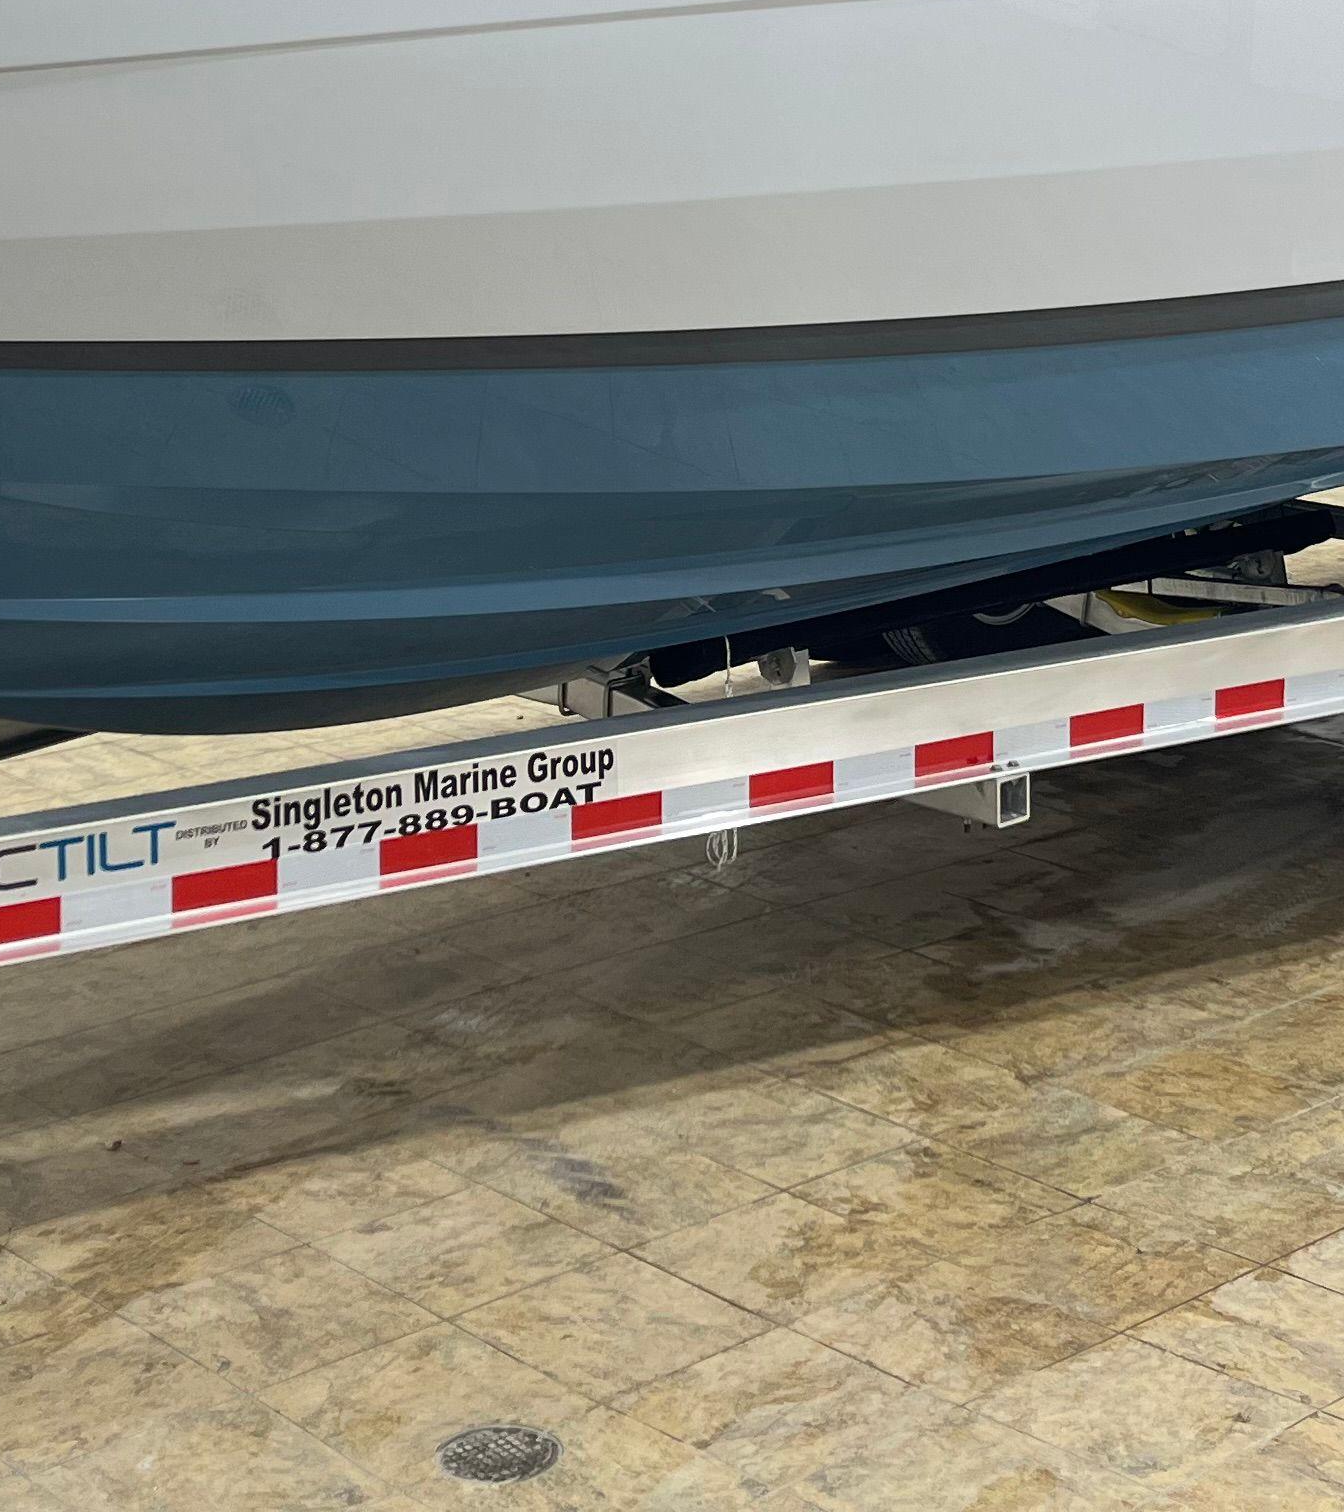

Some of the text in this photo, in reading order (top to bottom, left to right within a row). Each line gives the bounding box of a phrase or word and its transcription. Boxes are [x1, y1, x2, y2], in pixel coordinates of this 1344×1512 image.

[251, 747, 615, 831] Singleton Marine Group
[175, 819, 249, 841] DISTRIBUTED
[203, 836, 221, 849] BY
[262, 781, 602, 860] 1-877-889-BOAT
